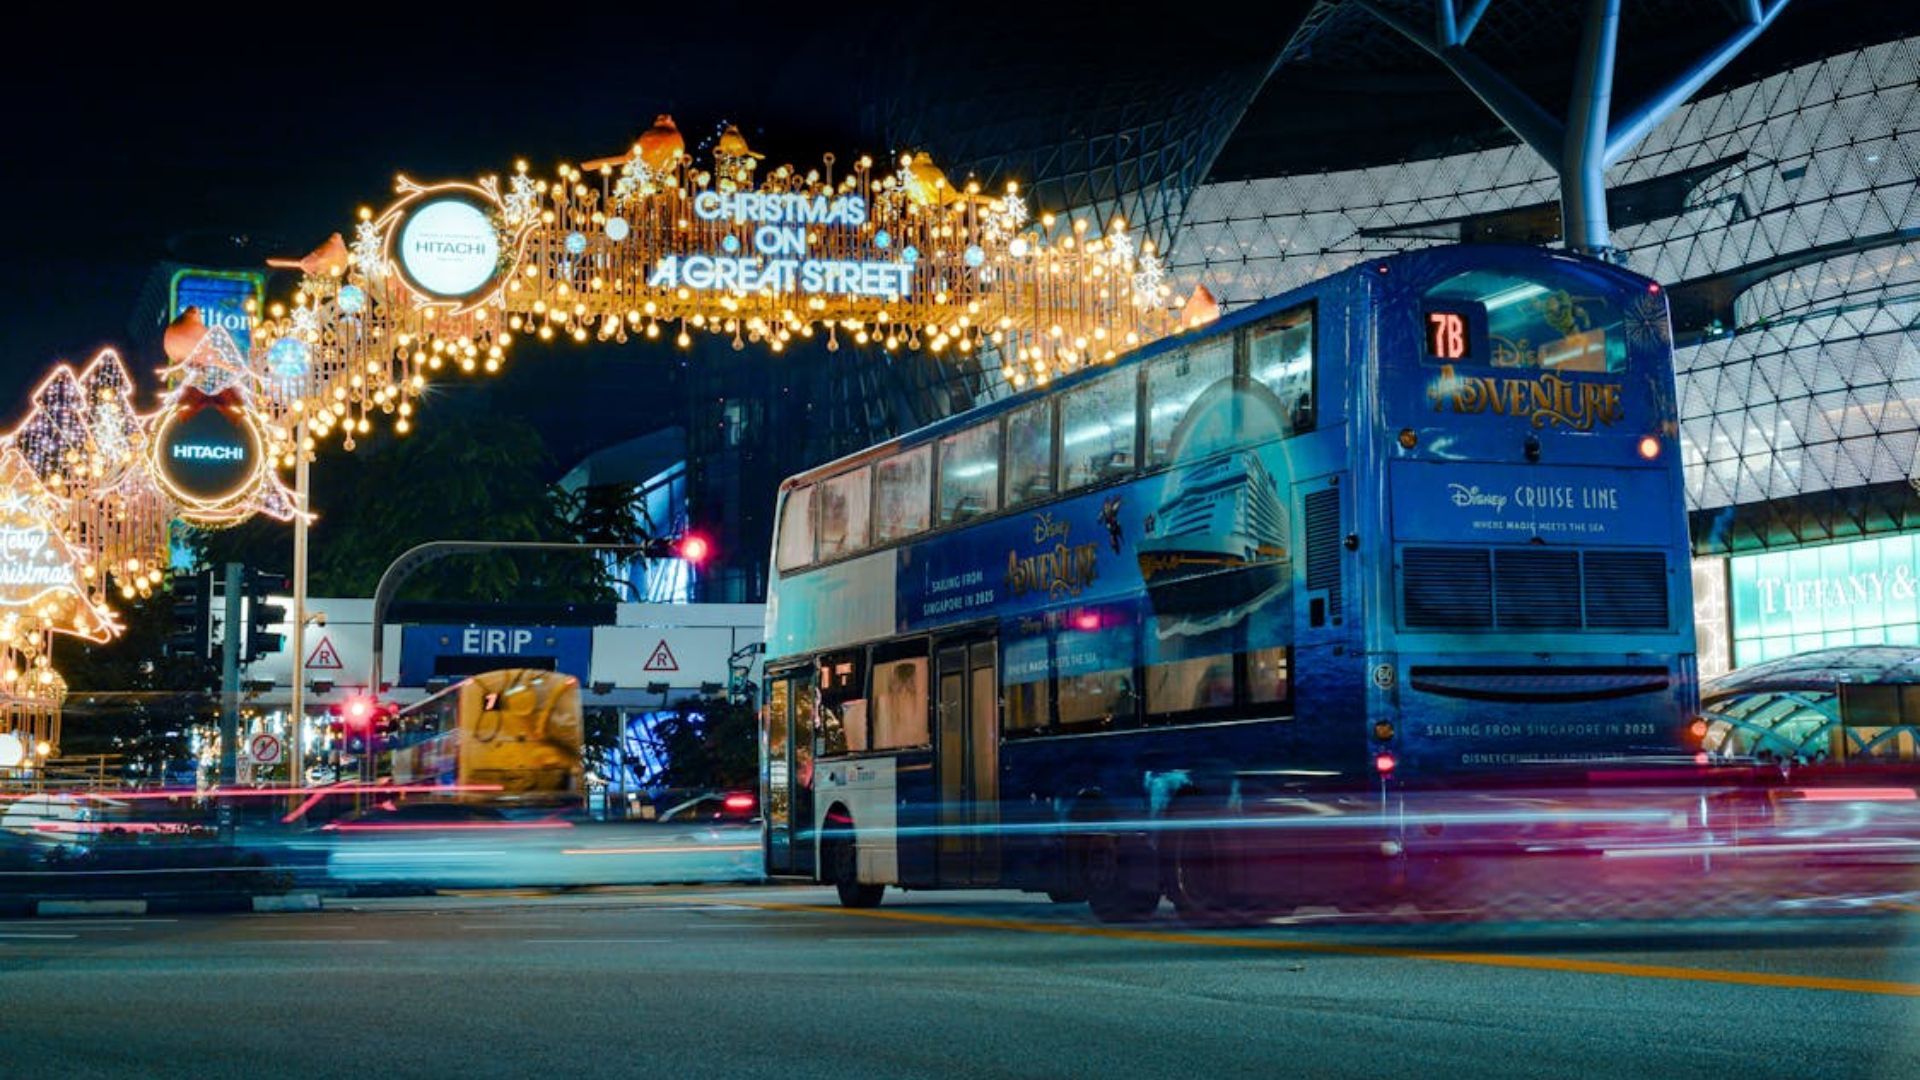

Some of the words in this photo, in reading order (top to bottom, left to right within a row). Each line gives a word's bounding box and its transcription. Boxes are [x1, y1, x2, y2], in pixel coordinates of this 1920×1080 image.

[694, 190, 866, 224] CHRISTMAS
[416, 240, 486, 255] HITACHI
[755, 225, 807, 255] ON
[648, 255, 678, 288] A
[682, 255, 799, 291] GREAT
[801, 259, 915, 296] STREET
[178, 304, 252, 331] ilton
[1429, 312, 1466, 359] 7B
[1427, 364, 1626, 430] ADVENTURE
[173, 444, 244, 460] HITACHI
[1447, 483, 1508, 514] Disney
[1515, 486, 1575, 510] CRUISE
[1583, 487, 1619, 510] LINE
[1472, 520, 1503, 530] WHERE
[1506, 521, 1536, 531] MAGIC
[1539, 522, 1567, 531] MEETS
[1569, 523, 1585, 532] THE
[1588, 523, 1605, 533] SEA
[931, 575, 961, 593] SAILING
[962, 571, 984, 587] FROM
[1757, 570, 1889, 614] TIFFANY
[1891, 564, 1918, 600] &
[923, 597, 963, 616] SINGAPORE
[319, 650, 331, 664] R
[656, 652, 668, 667] R
[1426, 724, 1480, 736] SAILING
[1485, 724, 1522, 736] FROM
[1527, 724, 1600, 736] SINGAPORE
[1605, 724, 1619, 735] IN
[1624, 723, 1656, 735] 2025
